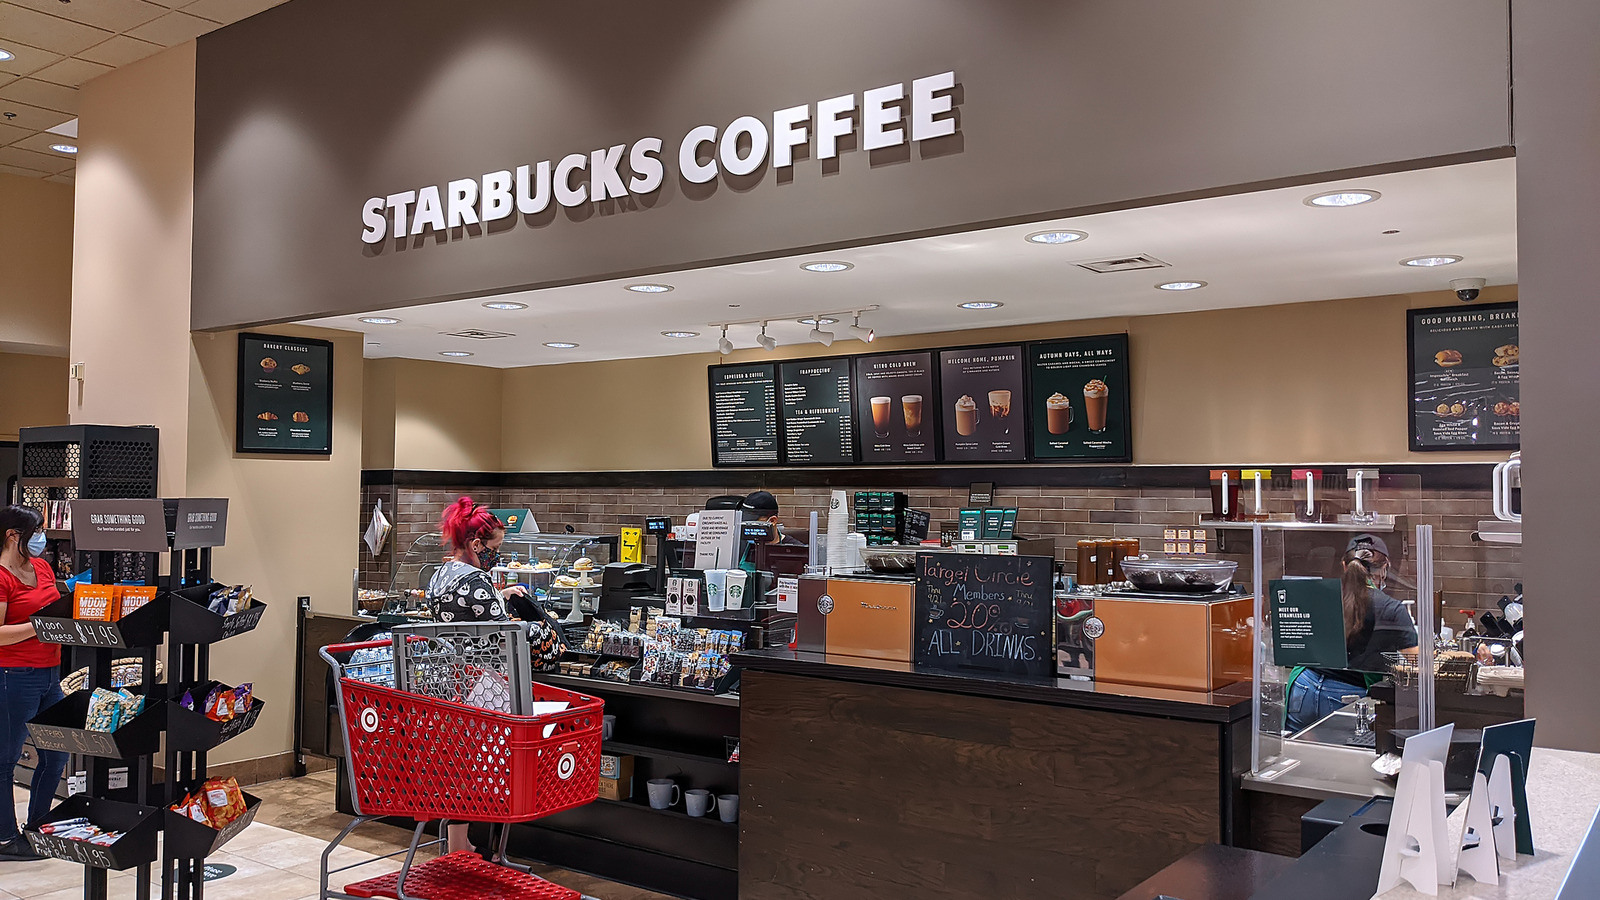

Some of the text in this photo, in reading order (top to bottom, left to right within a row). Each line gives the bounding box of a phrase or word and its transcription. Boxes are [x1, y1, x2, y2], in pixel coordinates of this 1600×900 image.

[361, 70, 956, 244] STARBUCKS COFFEE
[1446, 314, 1486, 323] MORNING,
[1490, 312, 1519, 320] BREAK
[90, 514, 145, 525] GRAB SOMETHING GOOD
[195, 513, 209, 522] SOMETHING
[974, 563, 1034, 586] Circle
[927, 584, 941, 595] Thru
[953, 584, 1005, 601] Members
[1016, 590, 1033, 600] Thru
[80, 597, 107, 608] MOON
[122, 596, 149, 607] MOON
[80, 607, 105, 616] CHEESE
[34, 618, 64, 630] Moon
[42, 631, 75, 642] Cheese
[74, 621, 118, 645] $4.95
[928, 630, 1035, 660] ALL DRINKS
[72, 730, 113, 754] $1.50
[29, 833, 66, 853] That's it
[35, 844, 52, 857] Fruit
[73, 842, 111, 867] $1.95
